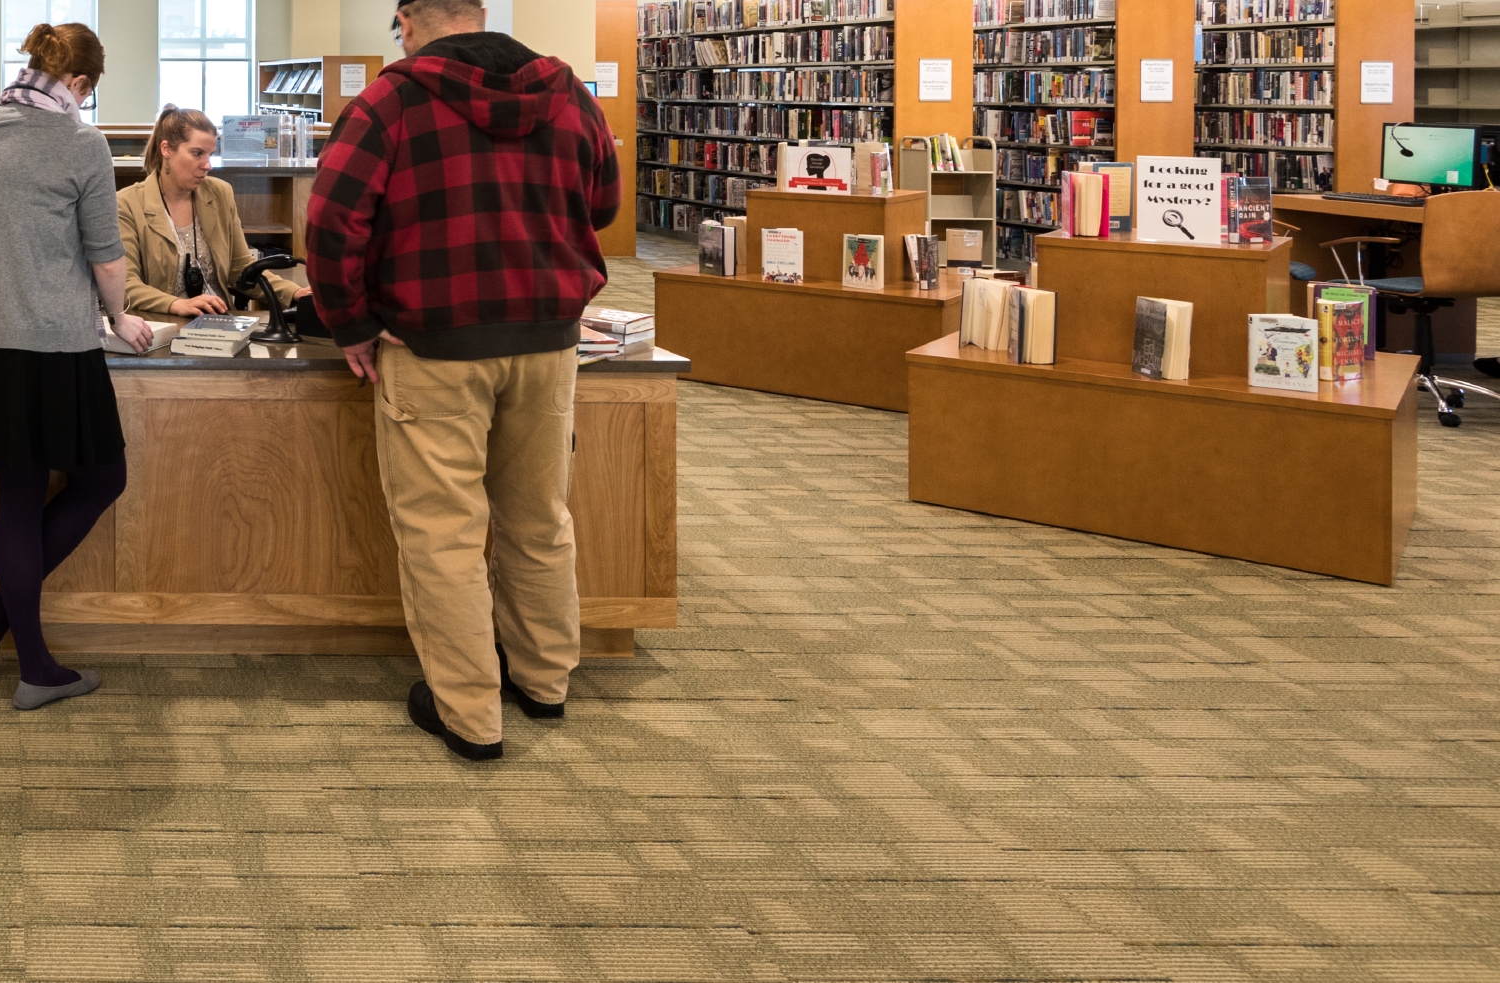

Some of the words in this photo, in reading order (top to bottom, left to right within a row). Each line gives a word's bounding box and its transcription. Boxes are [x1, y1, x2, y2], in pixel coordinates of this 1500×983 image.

[1143, 180, 1164, 188] for
[1180, 182, 1214, 191] good
[1146, 196, 1211, 206] Mystery?
[1238, 204, 1270, 212] ANCIENT
[1338, 318, 1360, 326] MALICE
[1335, 335, 1362, 343] FORTUNE
